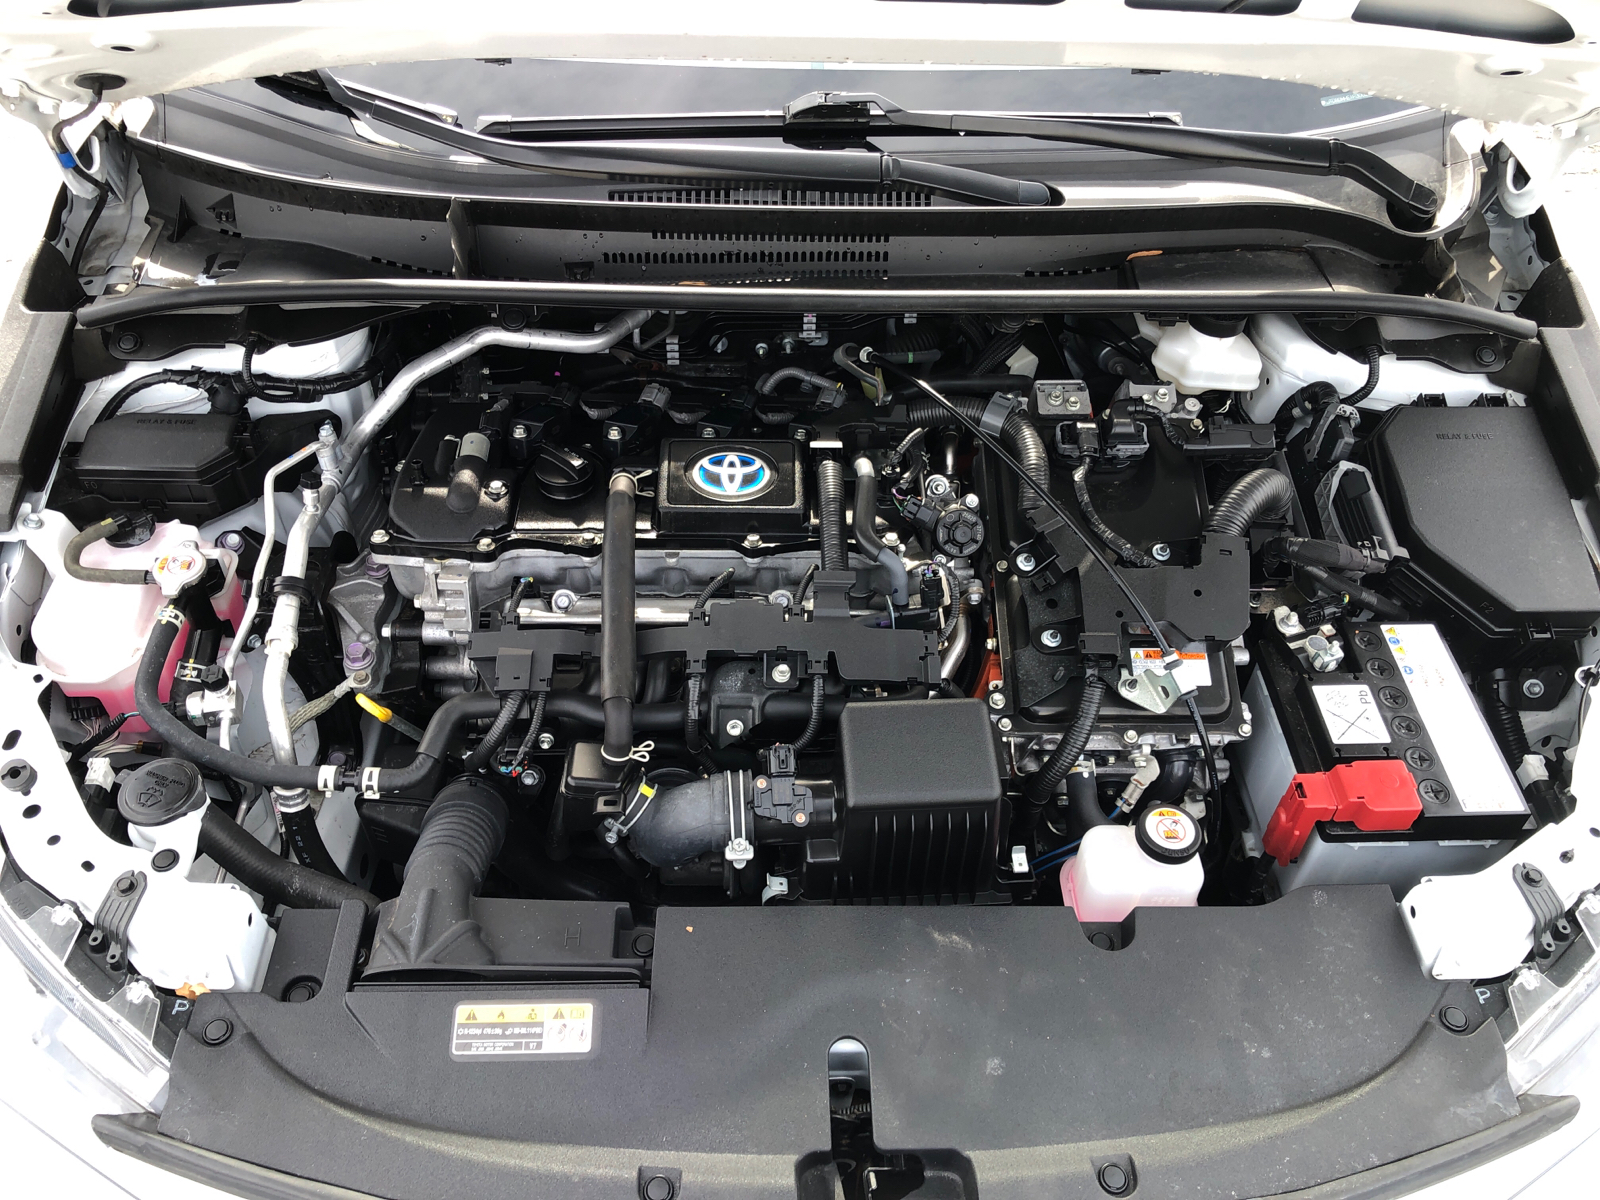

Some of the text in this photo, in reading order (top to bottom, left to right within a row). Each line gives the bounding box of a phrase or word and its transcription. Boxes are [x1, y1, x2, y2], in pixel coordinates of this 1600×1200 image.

[1435, 432, 1462, 440] RELAY
[1471, 432, 1494, 440] FUSE
[1479, 601, 1495, 614] F2
[563, 926, 582, 947] H
[1474, 988, 1491, 1005] P
[171, 999, 190, 1016] P
